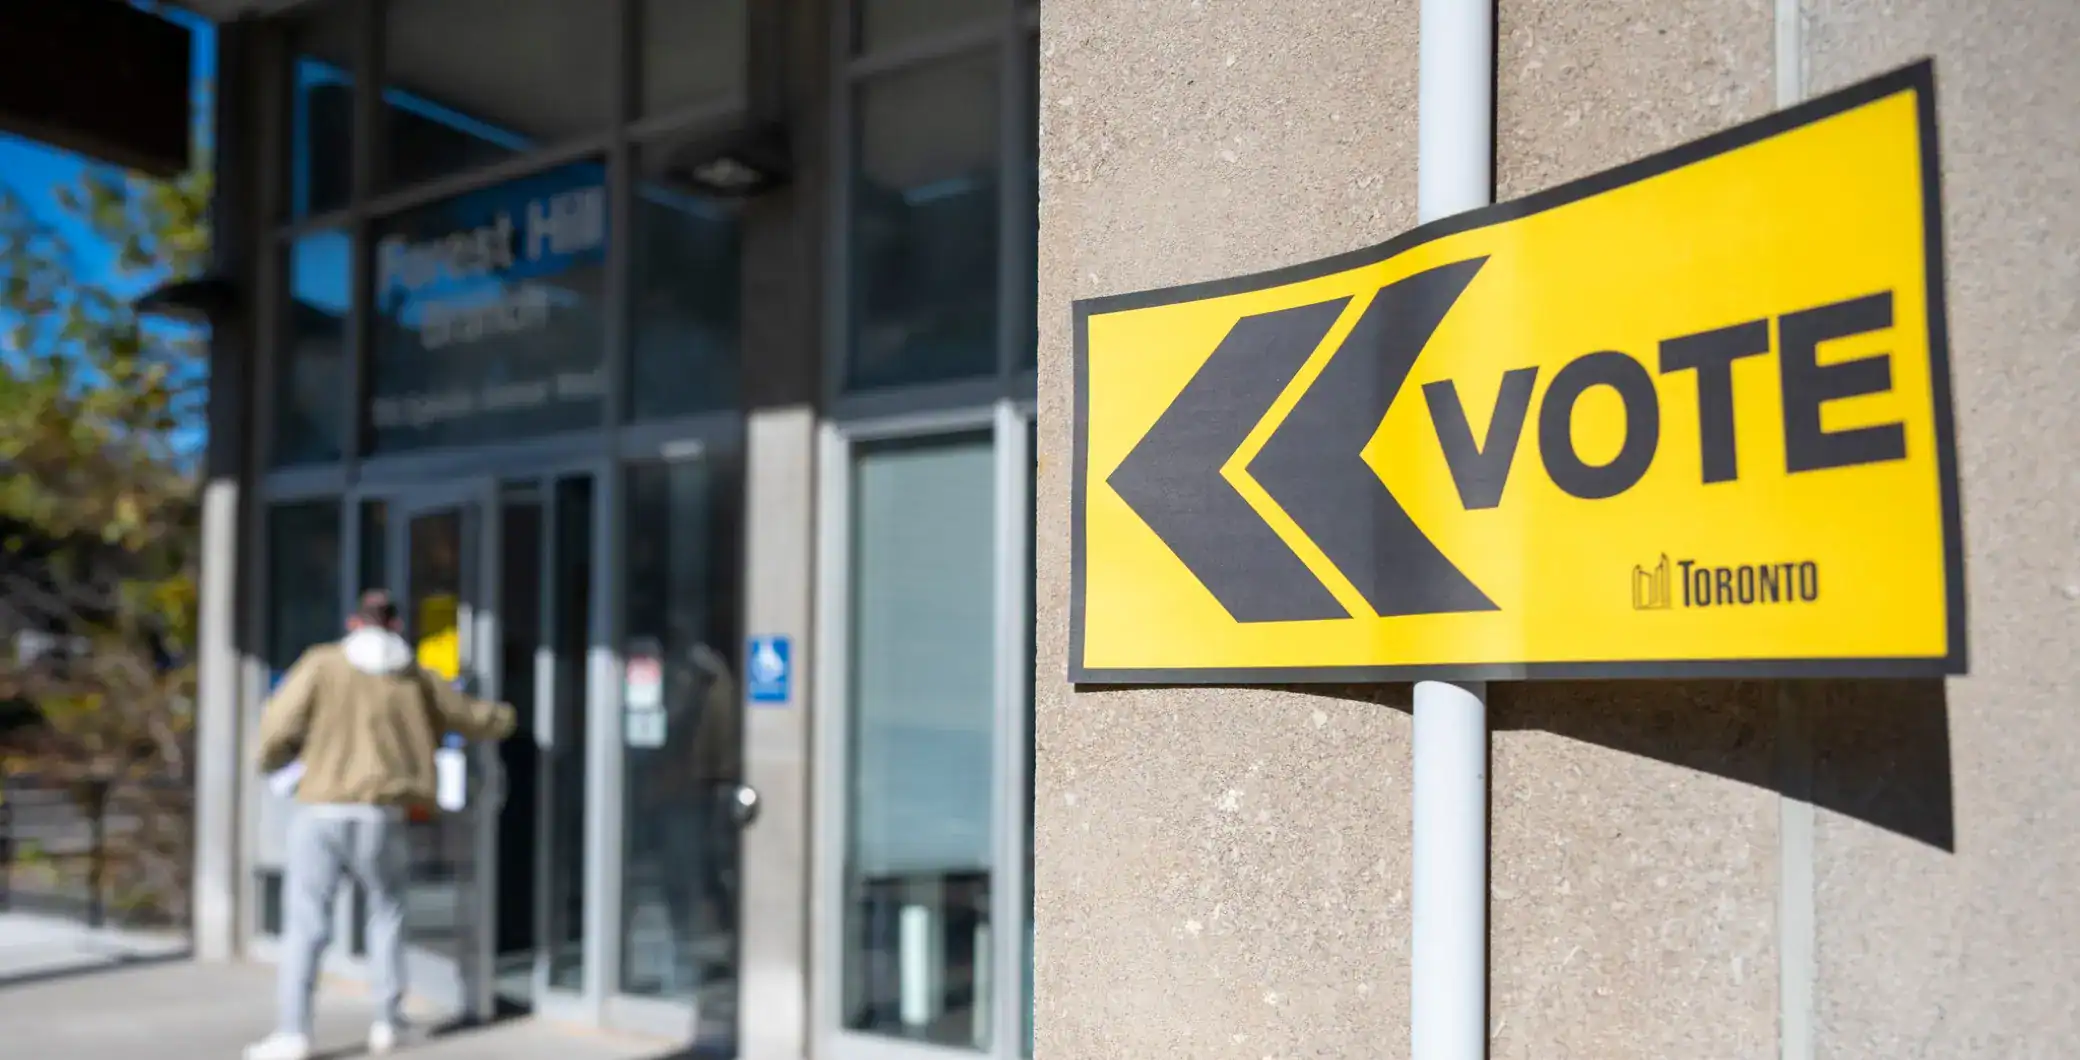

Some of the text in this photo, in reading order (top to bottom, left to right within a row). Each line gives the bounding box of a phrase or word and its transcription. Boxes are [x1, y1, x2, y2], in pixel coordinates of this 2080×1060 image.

[379, 187, 605, 295] Forest Hill
[1421, 288, 1908, 511] VOTE
[1677, 558, 1819, 607] TORONTO
